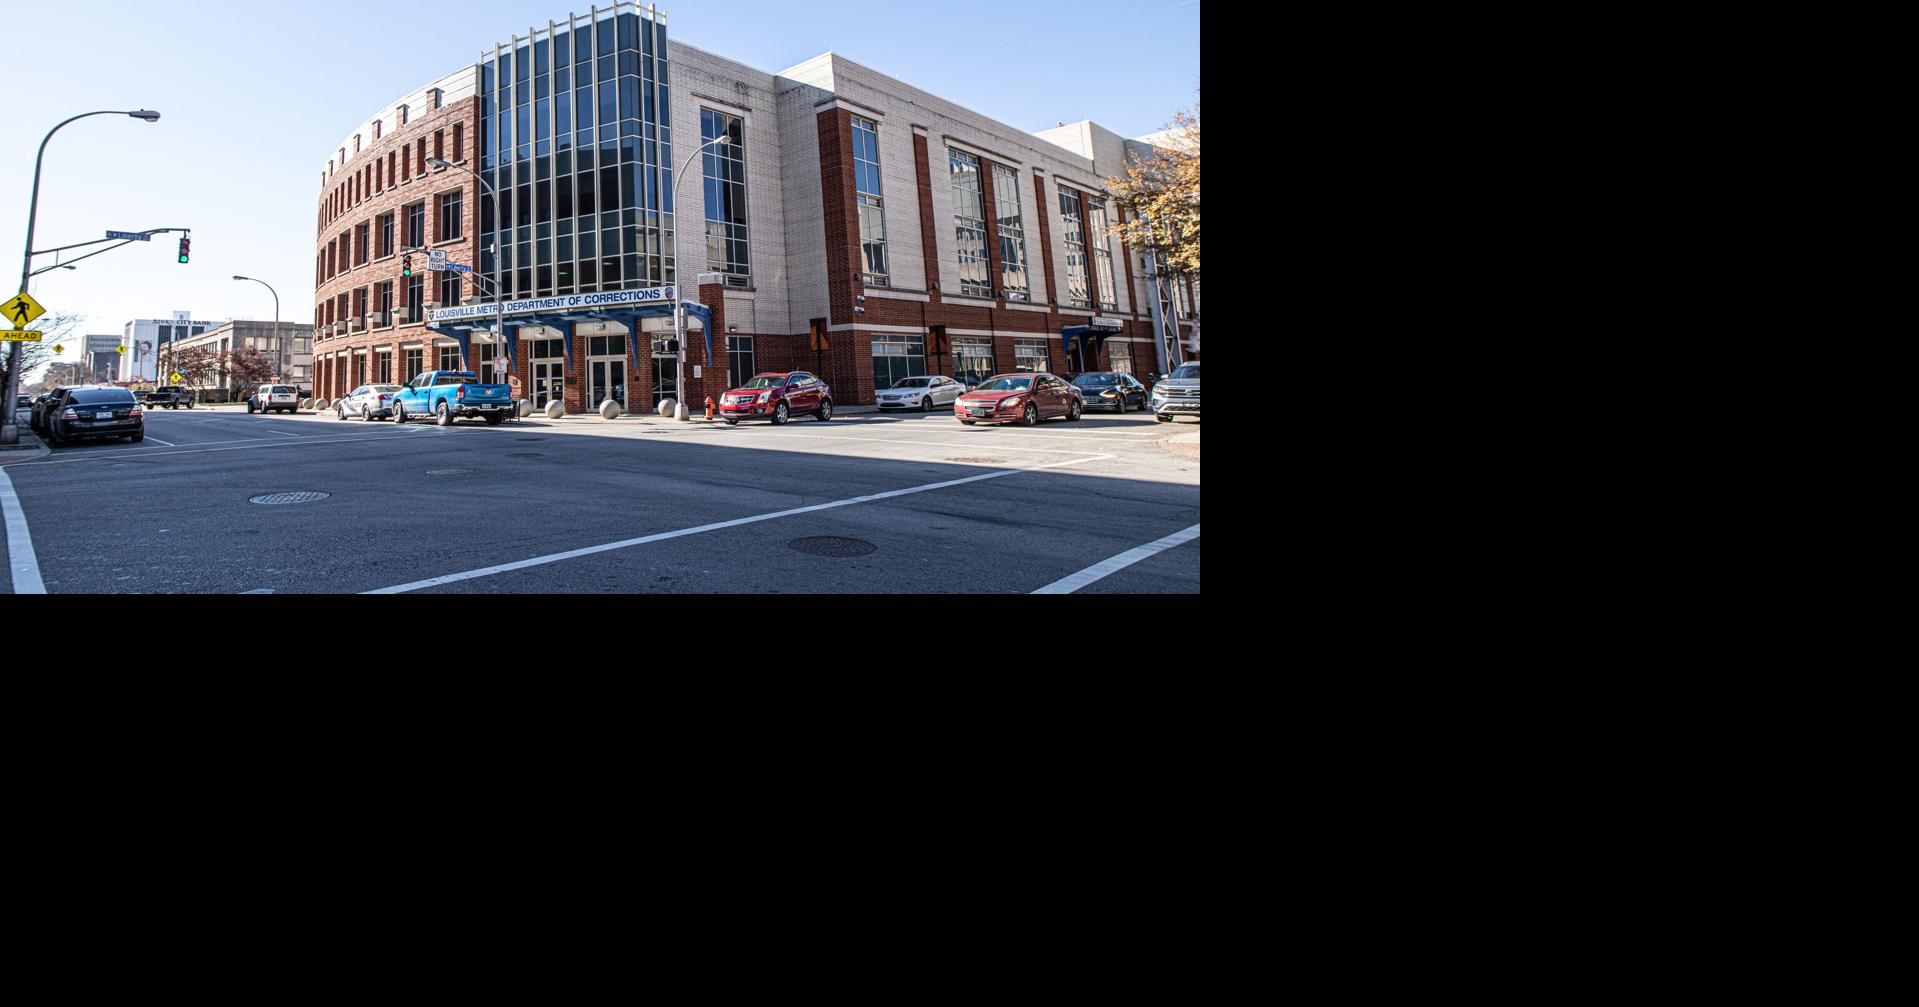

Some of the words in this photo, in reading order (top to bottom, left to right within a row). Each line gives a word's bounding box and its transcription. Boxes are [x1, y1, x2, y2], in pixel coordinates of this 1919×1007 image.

[436, 308, 475, 319] LOUISVILLE
[507, 298, 566, 311] DEPARTMENT
[568, 296, 582, 305] OF
[584, 289, 661, 304] CORRECTIONS
